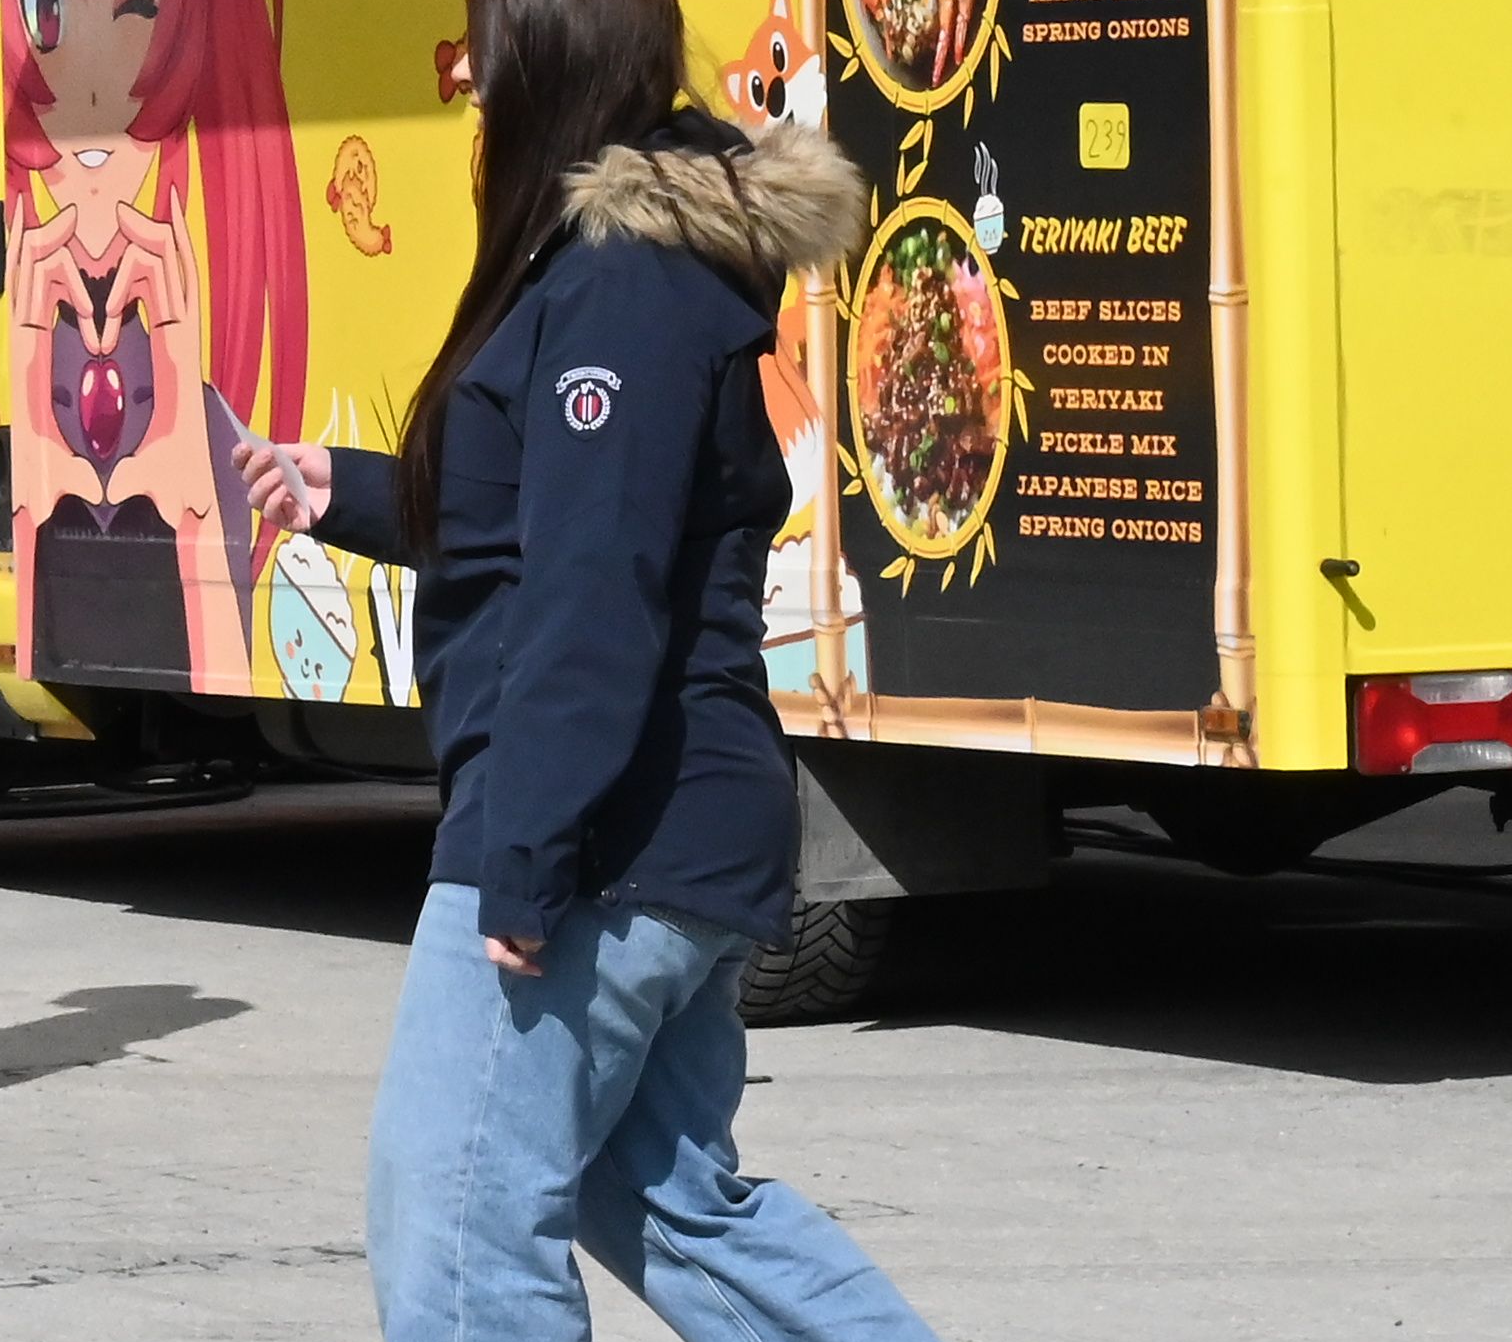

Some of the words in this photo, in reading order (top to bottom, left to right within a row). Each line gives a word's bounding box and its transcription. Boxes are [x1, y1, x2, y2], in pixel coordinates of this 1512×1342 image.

[1022, 21, 1102, 43] SPRING
[1107, 17, 1190, 39] ONIONS
[1085, 119, 1128, 160] 239
[1019, 216, 1122, 254] TERIYAKI
[1126, 216, 1187, 253] BEEF
[1030, 299, 1092, 321] BEEF
[1099, 300, 1181, 323] SLICES
[1043, 345, 1135, 366] COOKED
[1141, 345, 1169, 367] IN
[1050, 388, 1164, 411] TERIYAKI
[1040, 431, 1124, 454] PICKLE
[1130, 433, 1177, 455] MIX
[1016, 475, 1138, 500] JAPANESE
[1144, 479, 1203, 501] RICE
[1018, 515, 1105, 539] SPRING
[1110, 519, 1203, 542] ONIONS
